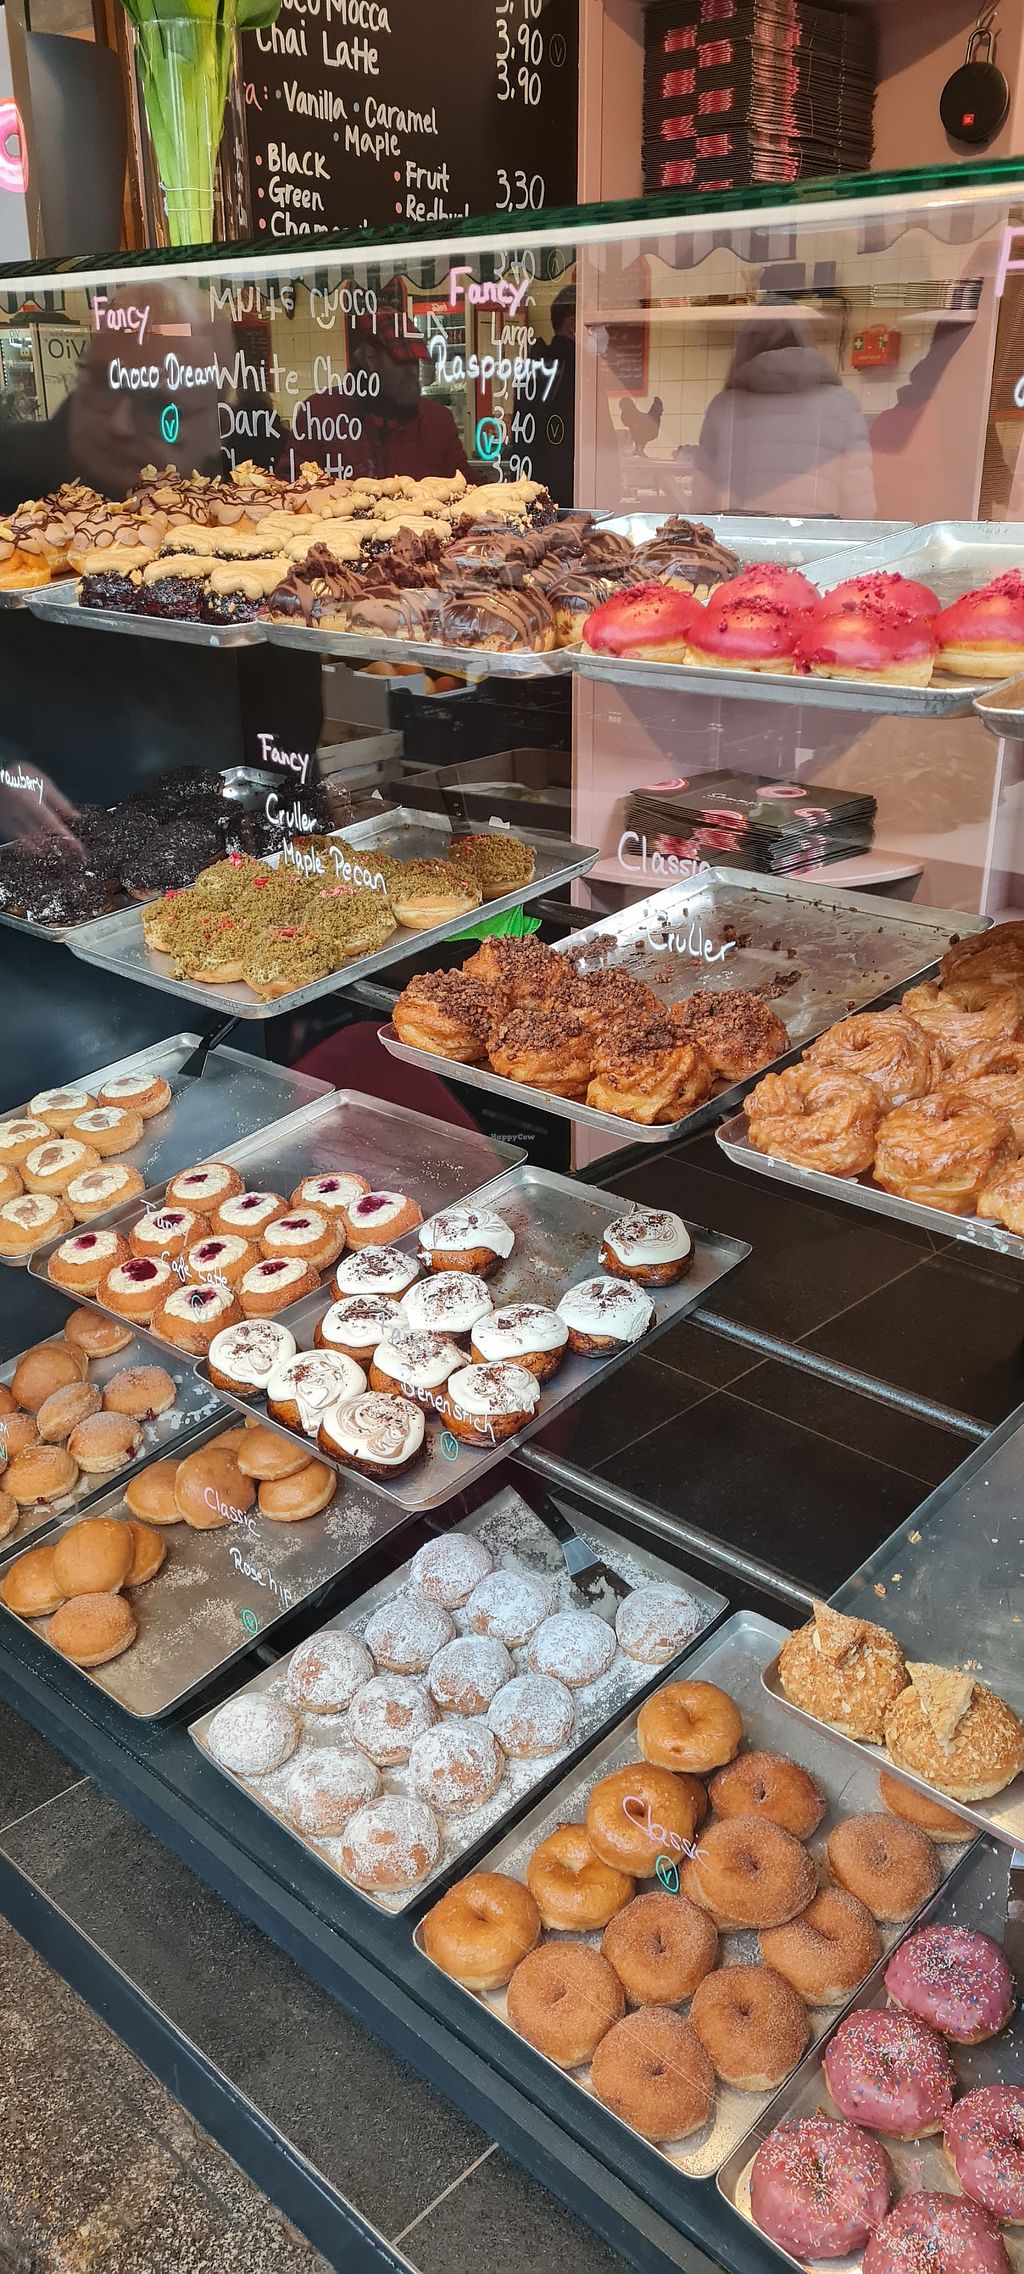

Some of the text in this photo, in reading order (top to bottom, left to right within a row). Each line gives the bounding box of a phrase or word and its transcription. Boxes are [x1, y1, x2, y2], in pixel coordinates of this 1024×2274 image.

[326, 0, 392, 33] Mocca
[255, 20, 380, 75] Chai Latte
[496, 18, 544, 66] 3,90
[496, 60, 542, 105] 3,90
[283, 80, 348, 121] Vanilla
[365, 97, 439, 134] Caramel
[267, 142, 331, 180] Black
[345, 125, 401, 161] Maple
[268, 175, 325, 211] Green
[406, 160, 450, 192] Fruit
[496, 169, 545, 212] 3,30
[449, 265, 530, 318] Fancy
[94, 295, 150, 346] Fancy
[491, 310, 538, 360] Large
[110, 352, 218, 391] Choco Dream
[213, 350, 380, 397] White Choco
[429, 334, 560, 403] Raspberry
[217, 400, 362, 441] Dark Choco
[257, 732, 309, 785] Fancy
[266, 793, 317, 833] Cruller
[282, 836, 387, 895] Maple Pecan
[648, 909, 737, 963] Cruller
[204, 1486, 262, 1538] Classic
[229, 1547, 267, 1587] Rose
[622, 1794, 713, 1873] Classic
